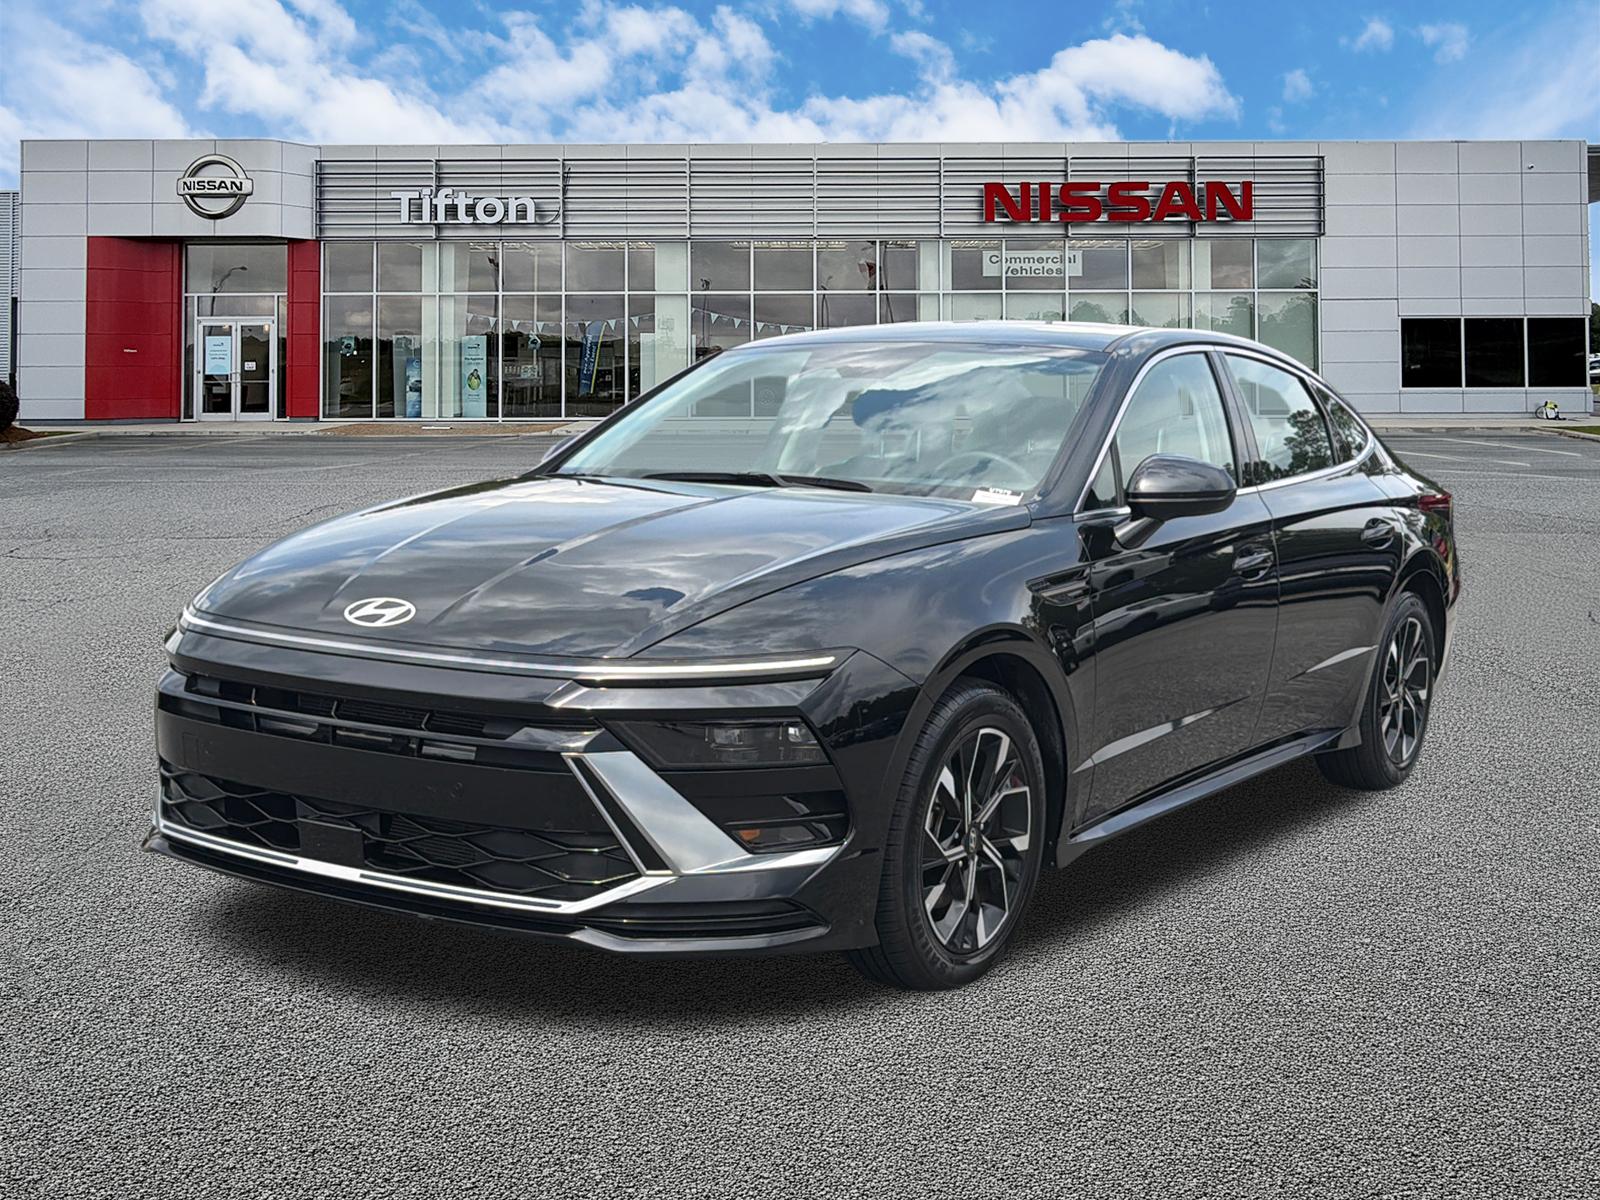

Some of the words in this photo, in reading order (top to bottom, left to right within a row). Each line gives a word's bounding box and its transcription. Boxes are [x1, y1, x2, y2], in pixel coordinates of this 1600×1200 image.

[182, 180, 243, 191] NISSAN
[983, 181, 1253, 222] NISSAN
[391, 187, 536, 224] Tifton
